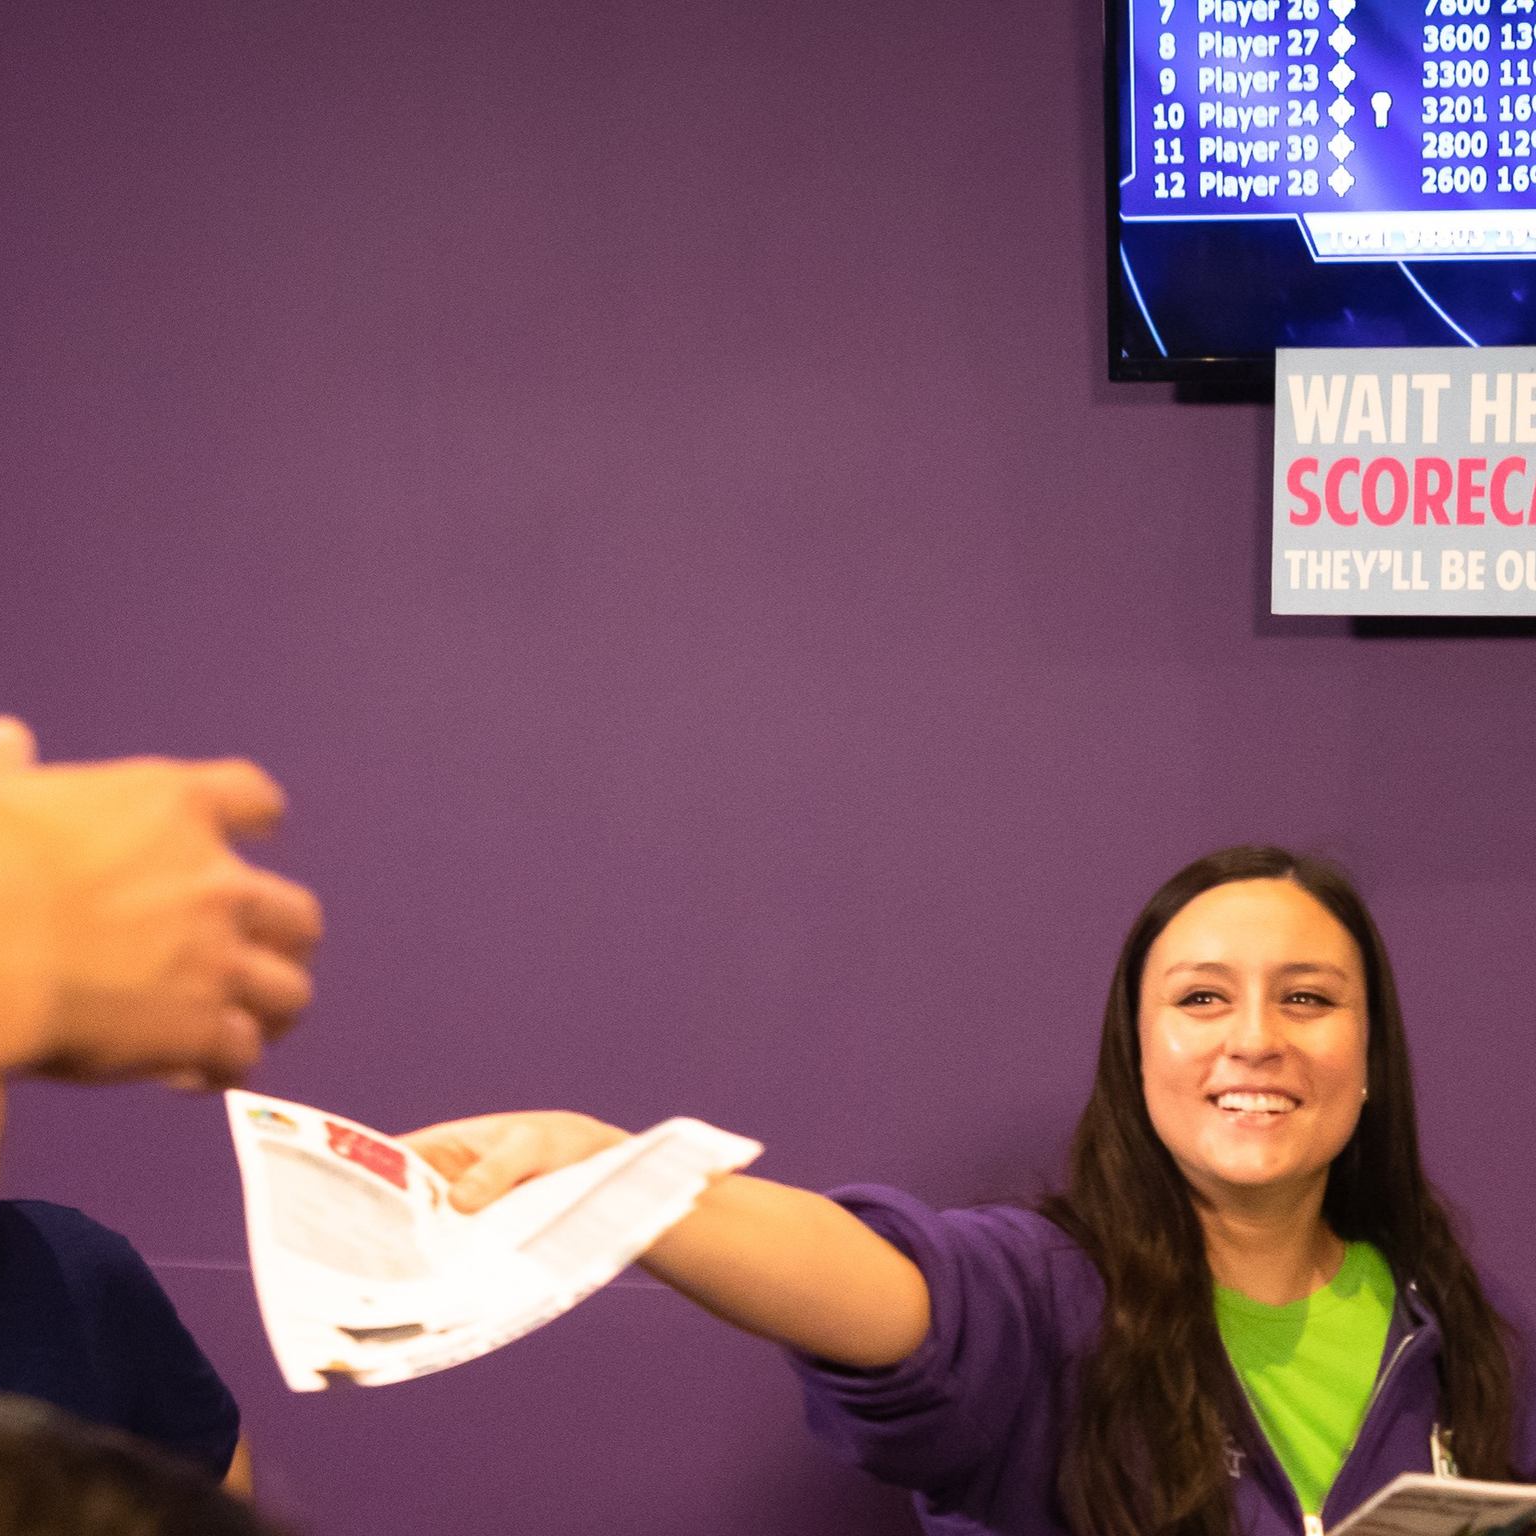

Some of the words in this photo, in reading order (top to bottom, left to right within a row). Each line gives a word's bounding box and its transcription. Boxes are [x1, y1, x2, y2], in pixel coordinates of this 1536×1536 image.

[1160, 0, 1174, 24] 7
[1199, 0, 1279, 27] Player
[1288, 0, 1319, 19] 26
[1160, 33, 1175, 59] 8
[1199, 31, 1279, 63] Player
[1288, 29, 1318, 55] 27
[1424, 24, 1489, 52] 3600
[1160, 68, 1175, 94] 9
[1200, 66, 1279, 98] Player
[1288, 65, 1318, 91] 23
[1423, 60, 1488, 87] 3300
[1154, 103, 1184, 129] 10
[1200, 101, 1279, 133] Player
[1288, 100, 1319, 126] 24
[1423, 96, 1487, 123] 3201
[1155, 138, 1184, 163] 11
[1200, 136, 1279, 167] Player
[1287, 135, 1318, 161] 39
[1423, 131, 1487, 158] 2800
[1155, 172, 1185, 197] 12
[1200, 171, 1279, 201] Player
[1288, 169, 1318, 195] 28
[1422, 166, 1486, 193] 2600
[1288, 373, 1451, 444] WAIT
[1285, 549, 1429, 591] THEY'LL
[1440, 549, 1486, 591] BE
